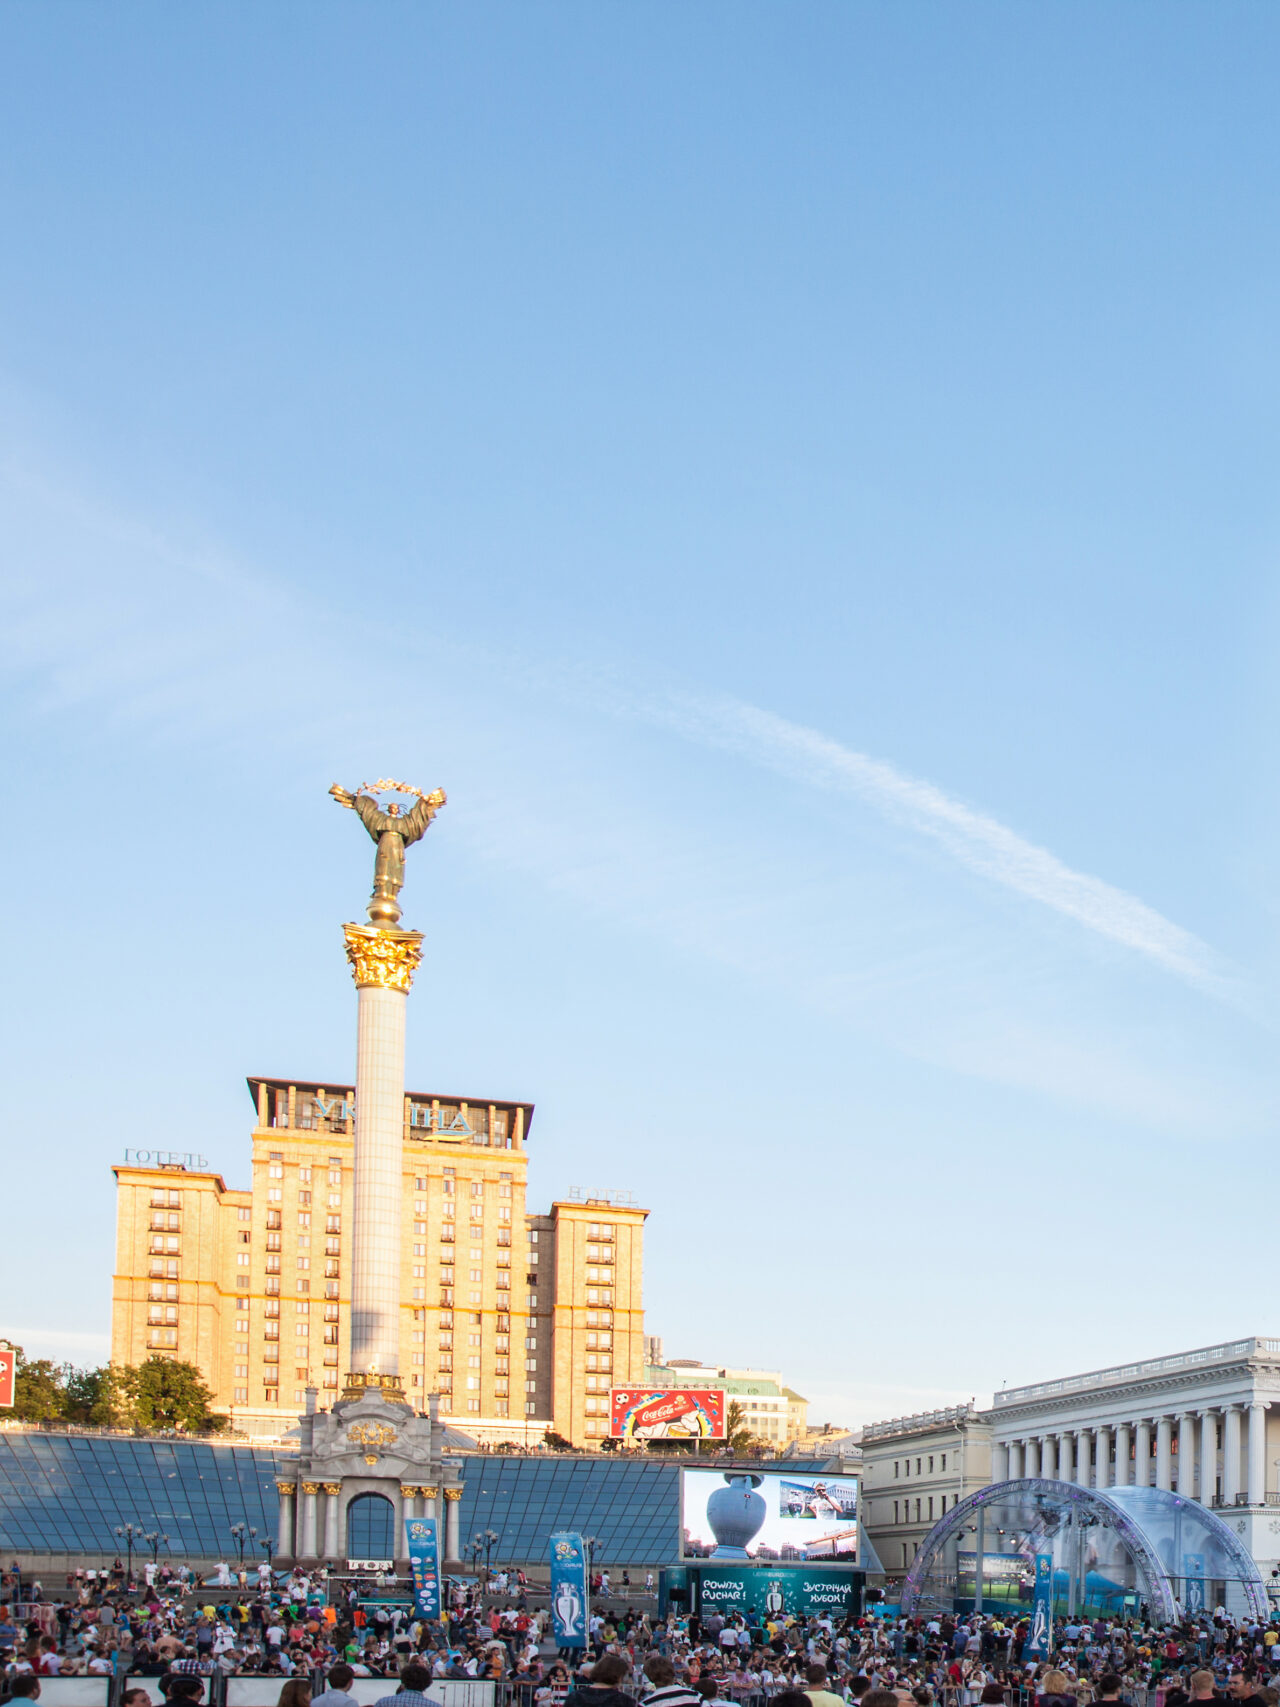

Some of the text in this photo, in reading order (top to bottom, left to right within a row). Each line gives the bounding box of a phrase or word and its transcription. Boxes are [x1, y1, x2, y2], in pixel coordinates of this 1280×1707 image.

[312, 1097, 473, 1131] УКЇНА
[124, 1148, 209, 1168] ГОТЕЛЬ
[568, 1185, 639, 1204] HOTEL
[703, 1579, 744, 1591] POWITAJ
